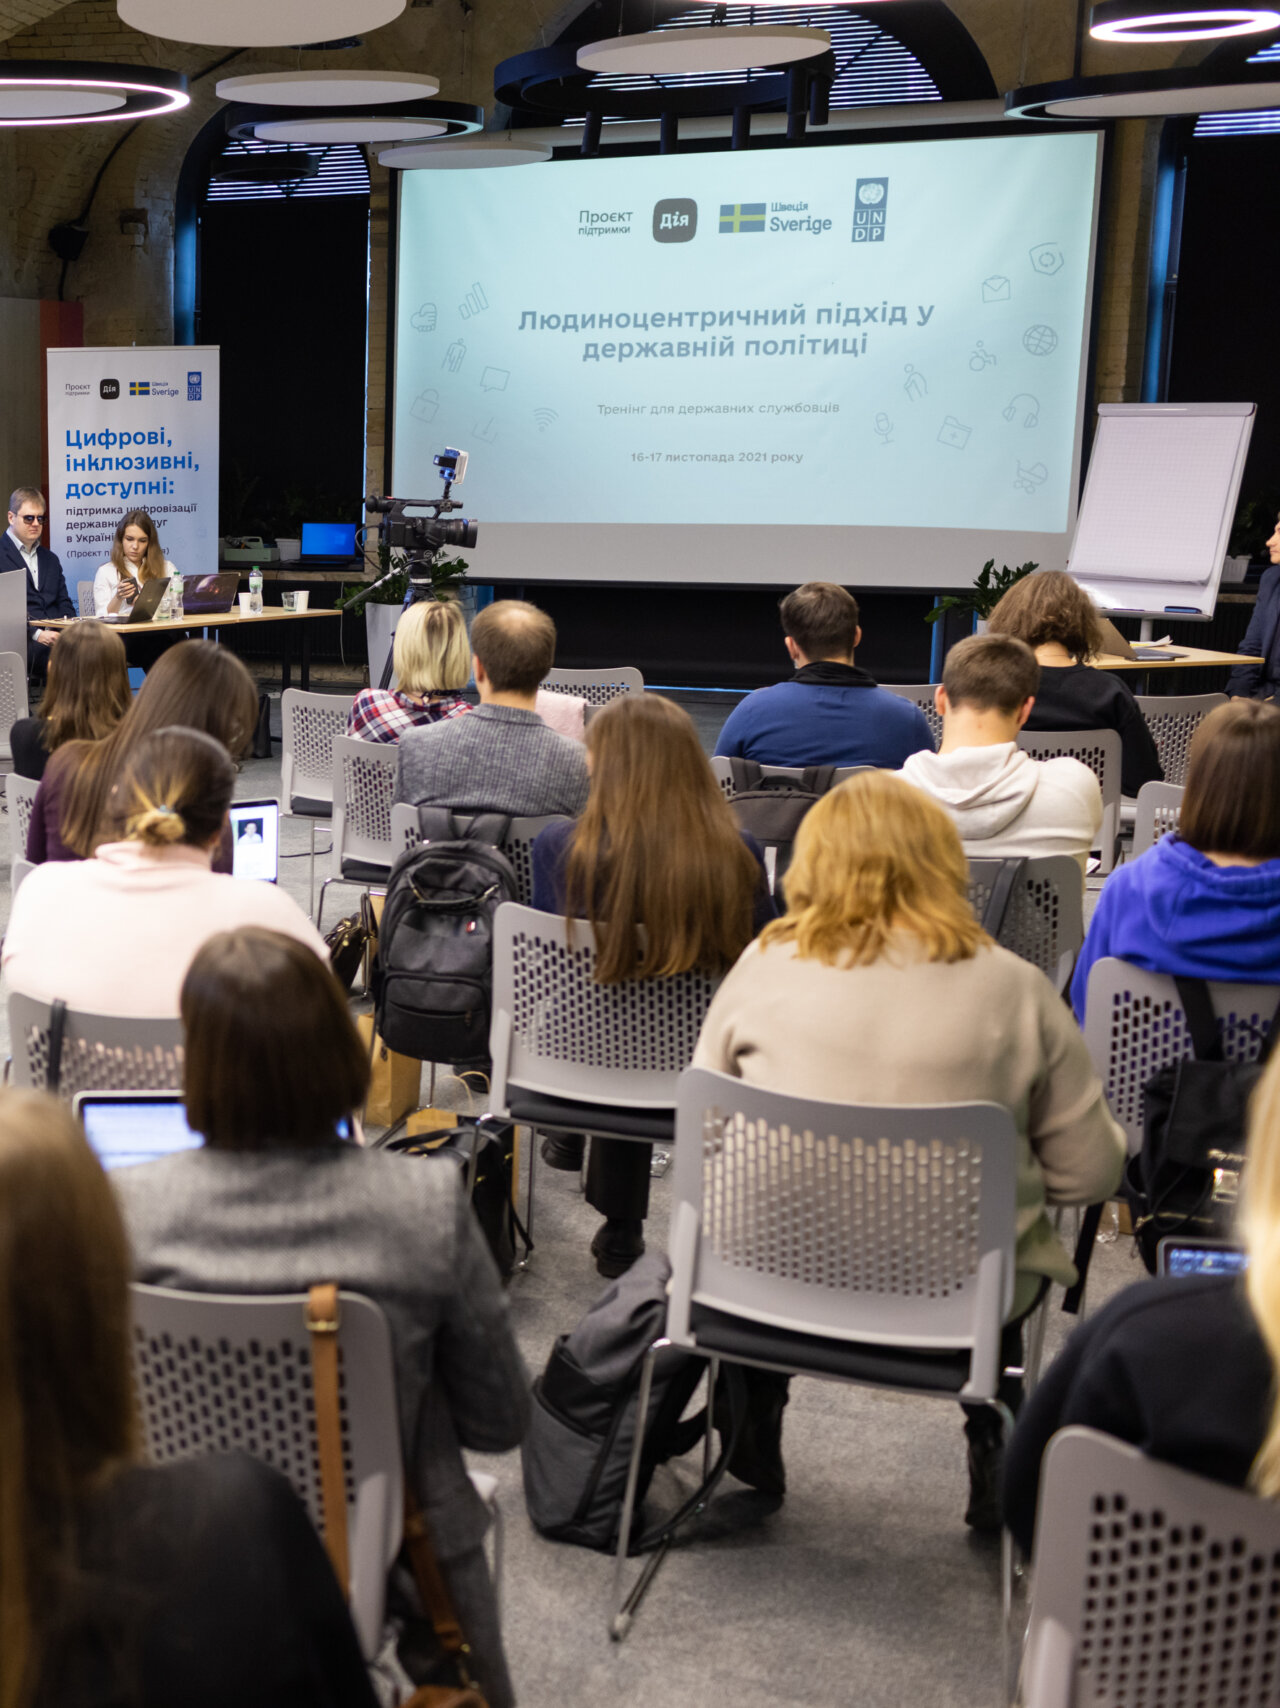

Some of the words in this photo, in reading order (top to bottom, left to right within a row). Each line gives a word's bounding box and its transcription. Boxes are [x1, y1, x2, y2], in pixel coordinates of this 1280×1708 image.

[771, 202, 808, 213] Швеція
[579, 210, 633, 225] Проєкт
[659, 211, 690, 230] Дія
[578, 226, 631, 237] підтримки
[770, 216, 832, 235] Sverige
[518, 304, 807, 332] Людиноцентричний
[816, 301, 908, 327] підхід
[916, 305, 935, 327] у
[582, 336, 735, 362] державній
[745, 333, 868, 357] політиці
[102, 385, 116, 393] Дія
[151, 388, 180, 397] Sverige
[597, 404, 647, 415] Тренінг
[650, 405, 675, 416] для
[678, 404, 754, 416] державних
[758, 402, 840, 415] службовців
[66, 427, 172, 449] Цифрові,
[66, 452, 200, 472] інклюзивні,
[631, 452, 662, 462] 16-17
[665, 453, 735, 463] листопада
[738, 452, 767, 462] 2021
[770, 453, 804, 464] року
[66, 477, 175, 499] доступні:
[66, 507, 123, 517] підтримка
[66, 520, 120, 531] державни
[75, 533, 114, 544] Україні
[67, 550, 102, 559] (Проєкт
